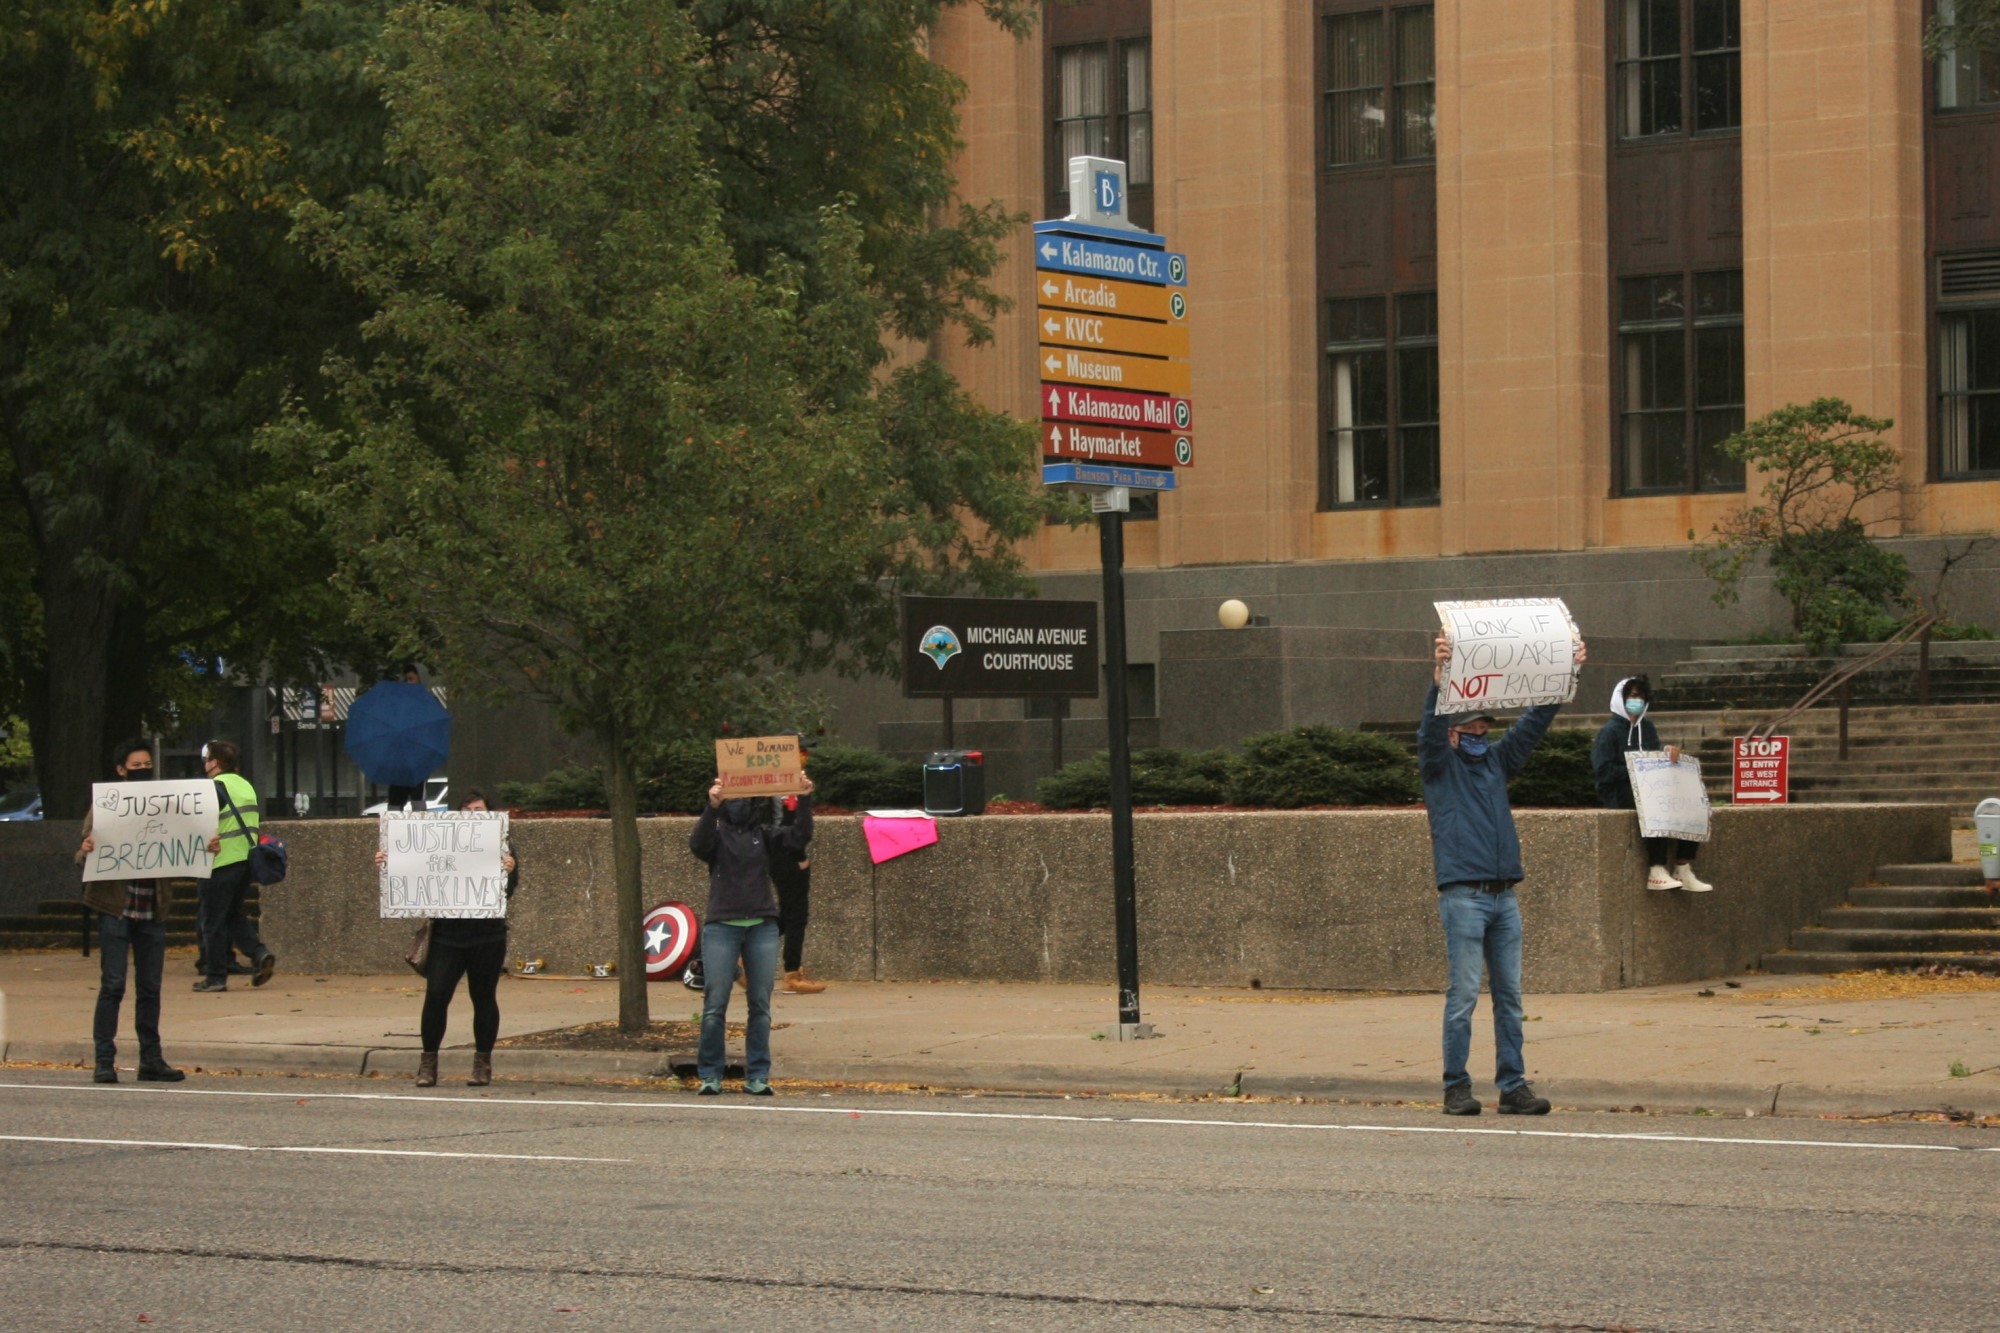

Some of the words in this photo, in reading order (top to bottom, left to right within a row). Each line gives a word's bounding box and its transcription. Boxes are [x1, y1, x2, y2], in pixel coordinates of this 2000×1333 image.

[1062, 241, 1134, 274] Kalamazoo
[1138, 253, 1162, 278] Ctr.
[1172, 260, 1181, 278] P
[1064, 279, 1117, 308] Arcadia
[1173, 297, 1183, 314] P
[1065, 316, 1104, 343] KVCC
[1066, 353, 1122, 382] Museum
[1068, 391, 1140, 421] Kalamazoo
[1143, 399, 1171, 425] Mall
[1178, 404, 1187, 423] P
[1069, 427, 1141, 459] Haymarket
[1179, 441, 1188, 460] P
[966, 627, 1034, 645] MICHIGAN
[1036, 628, 1087, 646] AVENUE
[1451, 611, 1521, 639] HONK
[1529, 614, 1550, 634] IF
[983, 653, 1074, 671] COURTHOUSE
[1457, 643, 1514, 674] YOU
[1517, 639, 1565, 667] ARE
[1446, 673, 1504, 699] NOT
[1504, 672, 1573, 695] RACIST
[1739, 741, 1782, 756] STOP
[1739, 760, 1750, 768] NO
[1752, 760, 1780, 768] ENTRY
[1756, 770, 1778, 778] WEST
[1740, 780, 1778, 788] ENTRANCE
[119, 792, 203, 817] JUSTICE
[136, 820, 168, 842] for
[395, 822, 484, 853] JUSTICE
[96, 834, 209, 874] BREONNA
[389, 875, 449, 907] BLACK
[453, 876, 500, 907] LIVES
